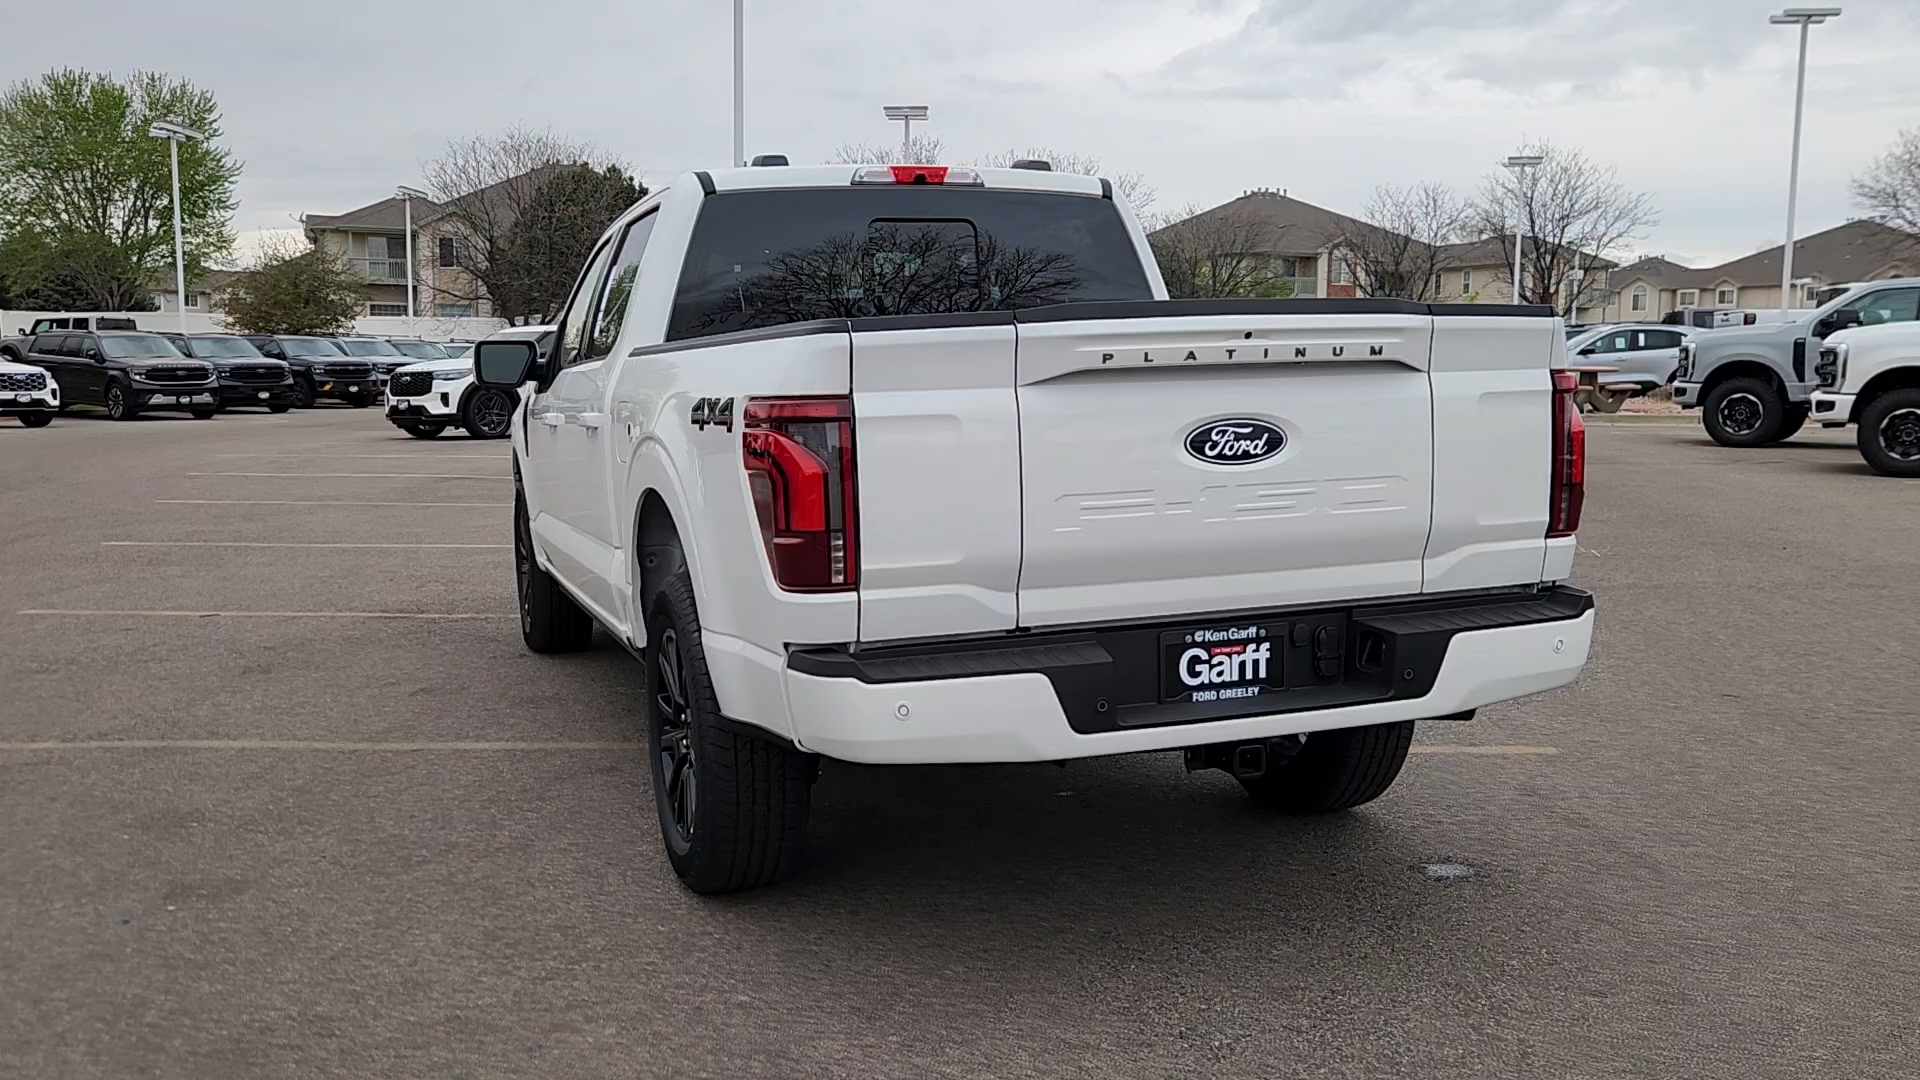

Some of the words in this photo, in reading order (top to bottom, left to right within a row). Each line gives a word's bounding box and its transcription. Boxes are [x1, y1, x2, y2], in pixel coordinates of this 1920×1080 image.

[1101, 345, 1384, 365] PLATINUM
[1204, 426, 1269, 457] Ford
[1204, 630, 1227, 642] Ken
[1228, 626, 1258, 639] Garff
[1179, 642, 1271, 686] Garff
[1192, 691, 1217, 703] FORD
[1219, 686, 1260, 699] GREELEY
